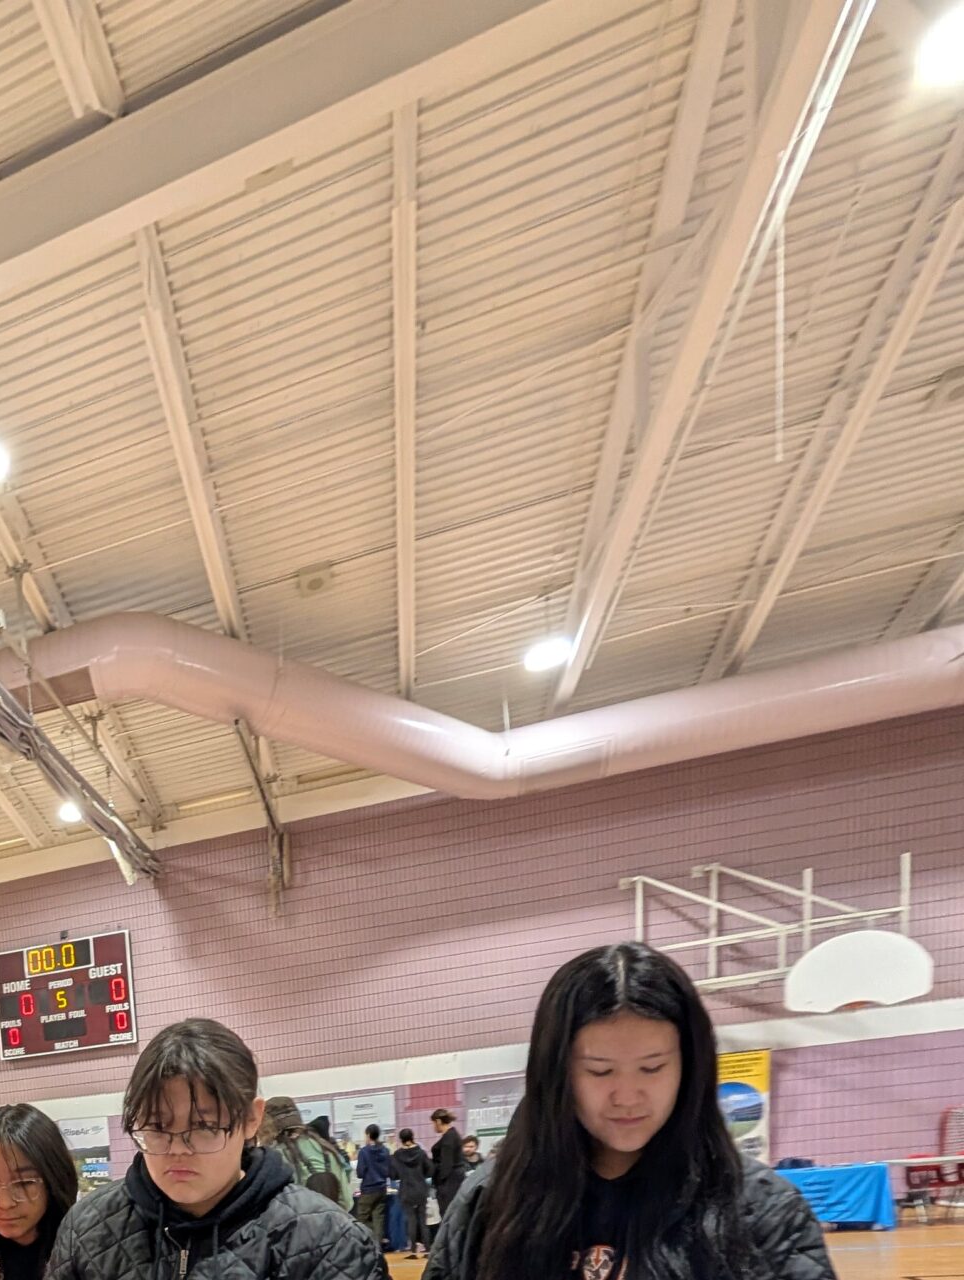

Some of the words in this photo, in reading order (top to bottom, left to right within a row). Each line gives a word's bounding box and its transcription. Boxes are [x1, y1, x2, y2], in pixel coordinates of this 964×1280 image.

[89, 963, 122, 979] GUEST
[2, 980, 31, 994] HOME
[48, 978, 73, 990] PERIOD
[111, 978, 126, 1001] 0
[20, 993, 34, 1016] 0
[106, 1002, 129, 1013] FOULS
[1, 1020, 22, 1028] FOULS
[40, 1013, 66, 1024] PLAYER
[68, 1010, 86, 1018] FOUL
[116, 1012, 128, 1030] 0
[8, 1028, 20, 1046] 0
[110, 1032, 132, 1042] SCORE
[54, 1040, 78, 1049] MATCH
[4, 1048, 25, 1056] SCORE
